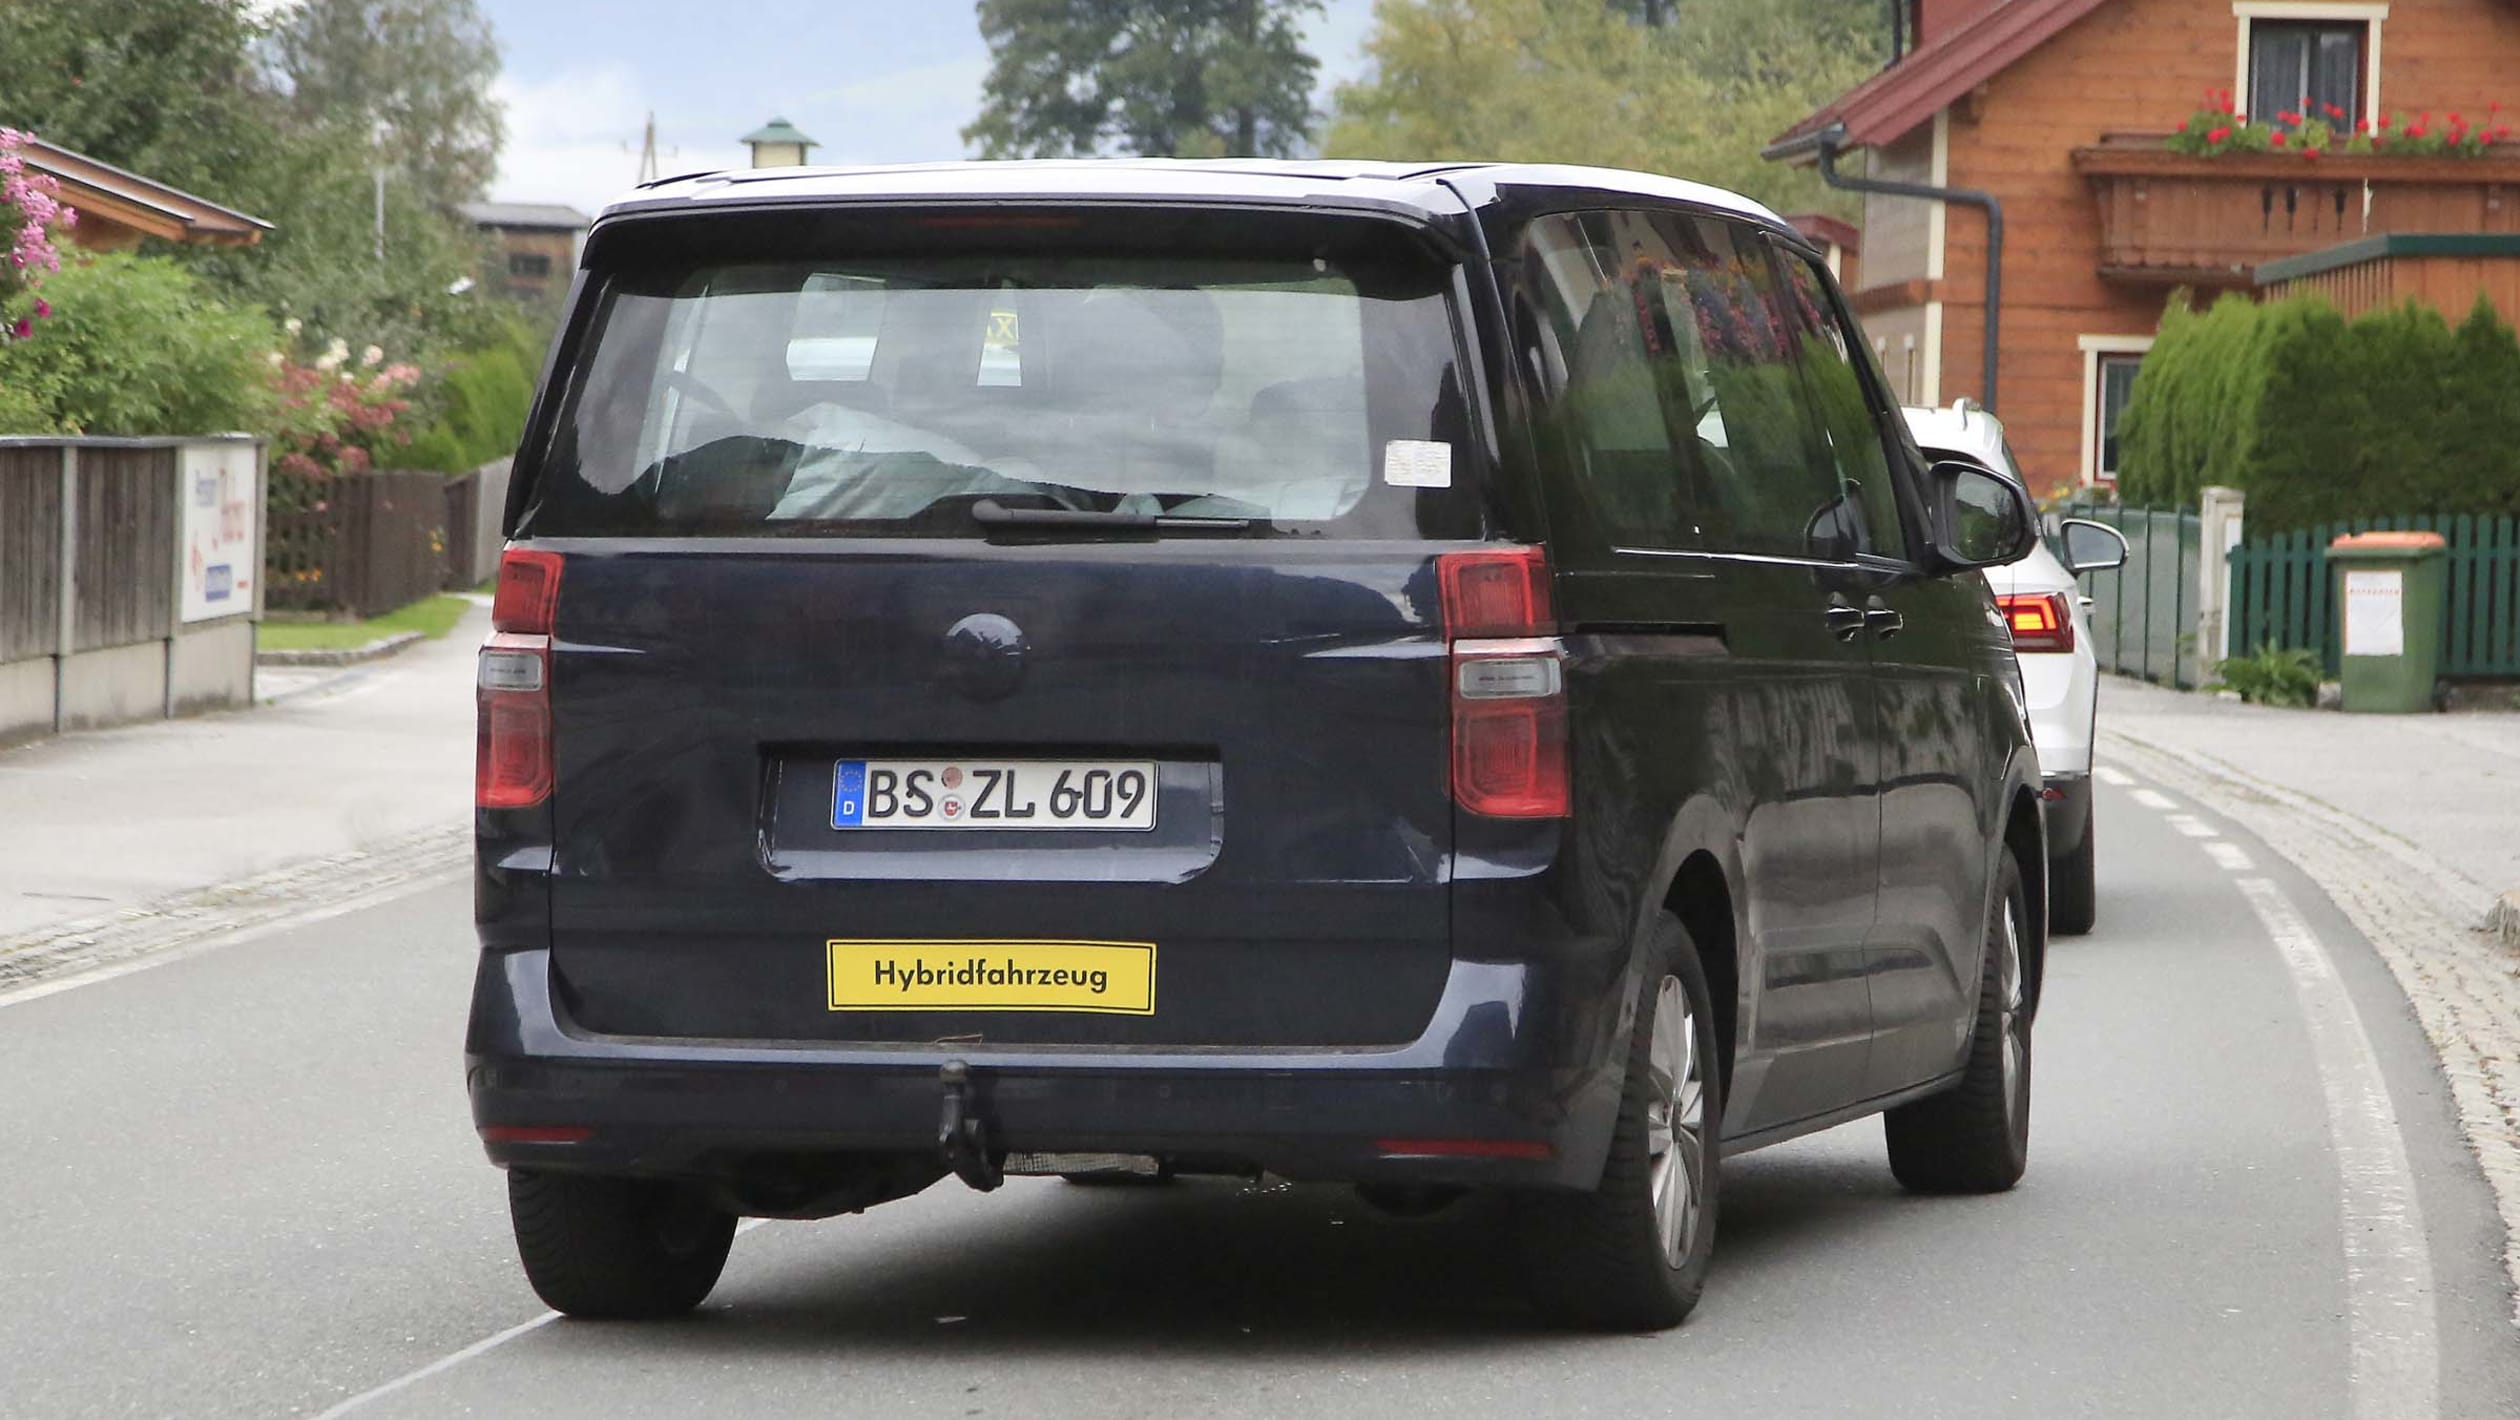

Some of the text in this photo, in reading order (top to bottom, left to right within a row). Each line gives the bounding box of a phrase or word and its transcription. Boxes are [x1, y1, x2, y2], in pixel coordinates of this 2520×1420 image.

[842, 801, 855, 815] D
[868, 769, 1146, 819] BS ZL 609
[874, 959, 1108, 993] Hybridfahrzeug
